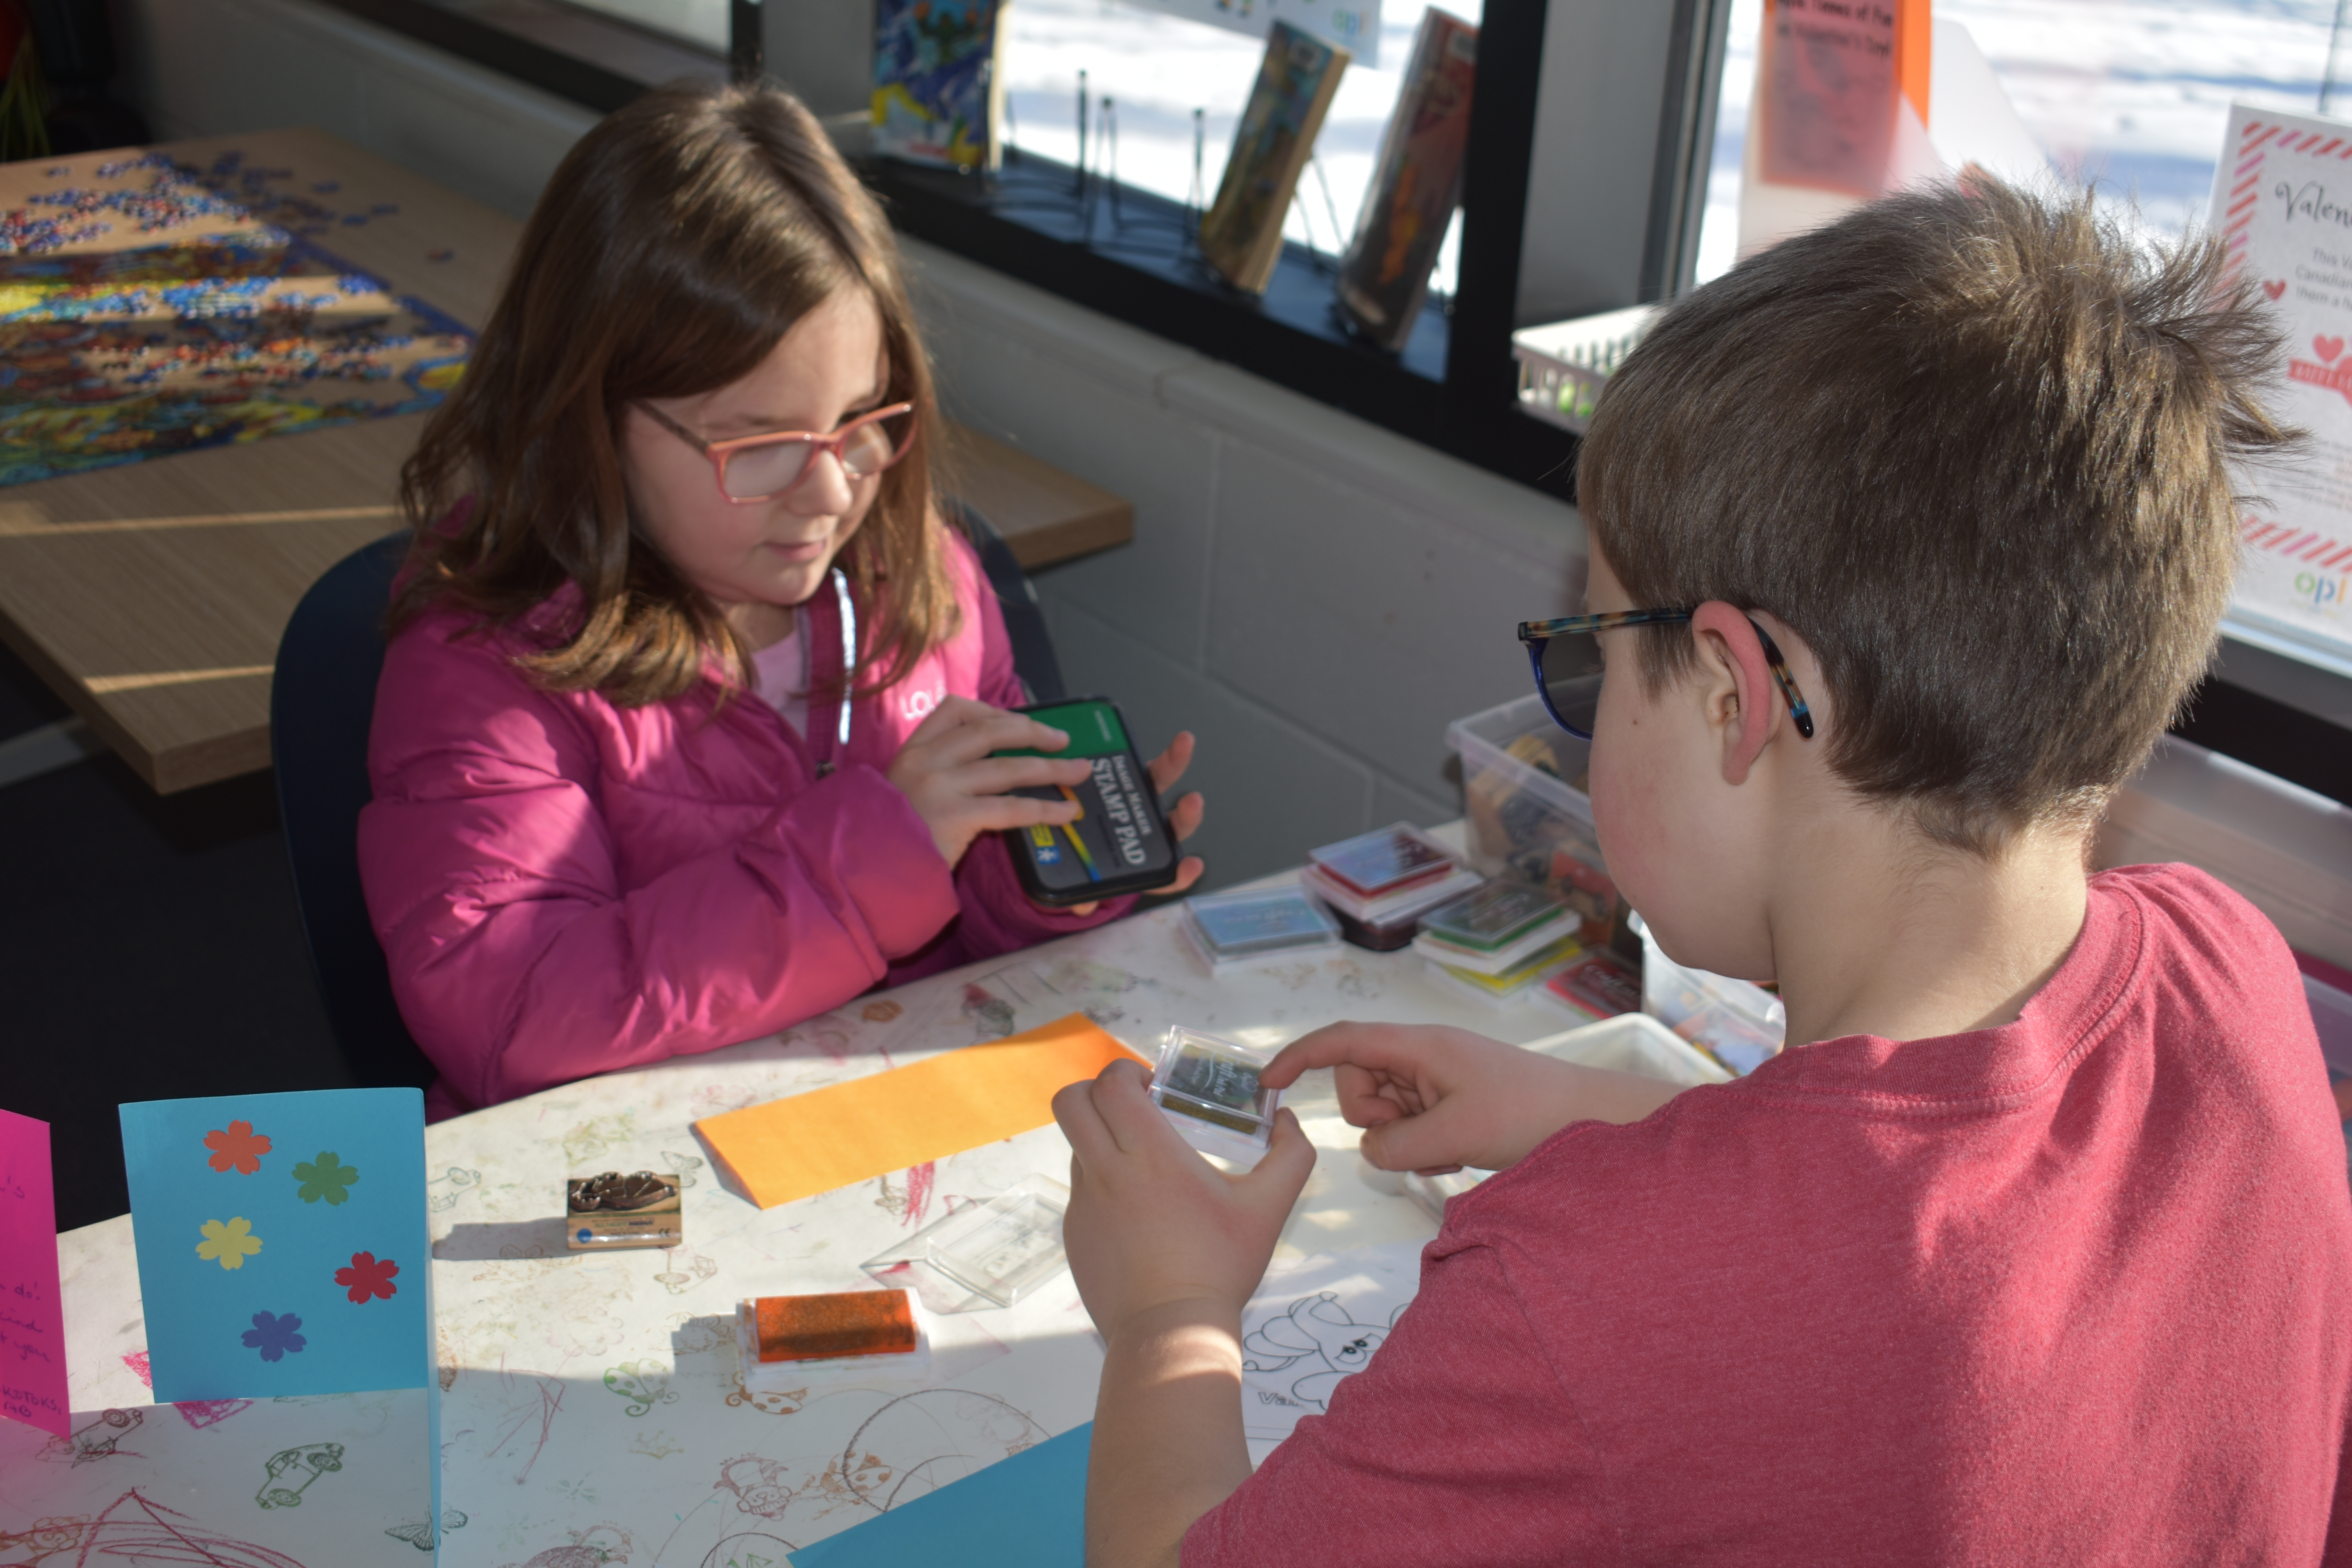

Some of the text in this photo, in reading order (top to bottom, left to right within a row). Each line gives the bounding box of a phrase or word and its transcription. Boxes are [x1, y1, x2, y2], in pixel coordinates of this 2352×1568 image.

[2275, 181, 2352, 229] Valen
[2313, 247, 2337, 267] This
[2296, 285, 2329, 303] them
[1091, 758, 1130, 822] STAMP
[1115, 824, 1147, 865] PAD
[1112, 755, 1153, 835] IMAGE MAKER
